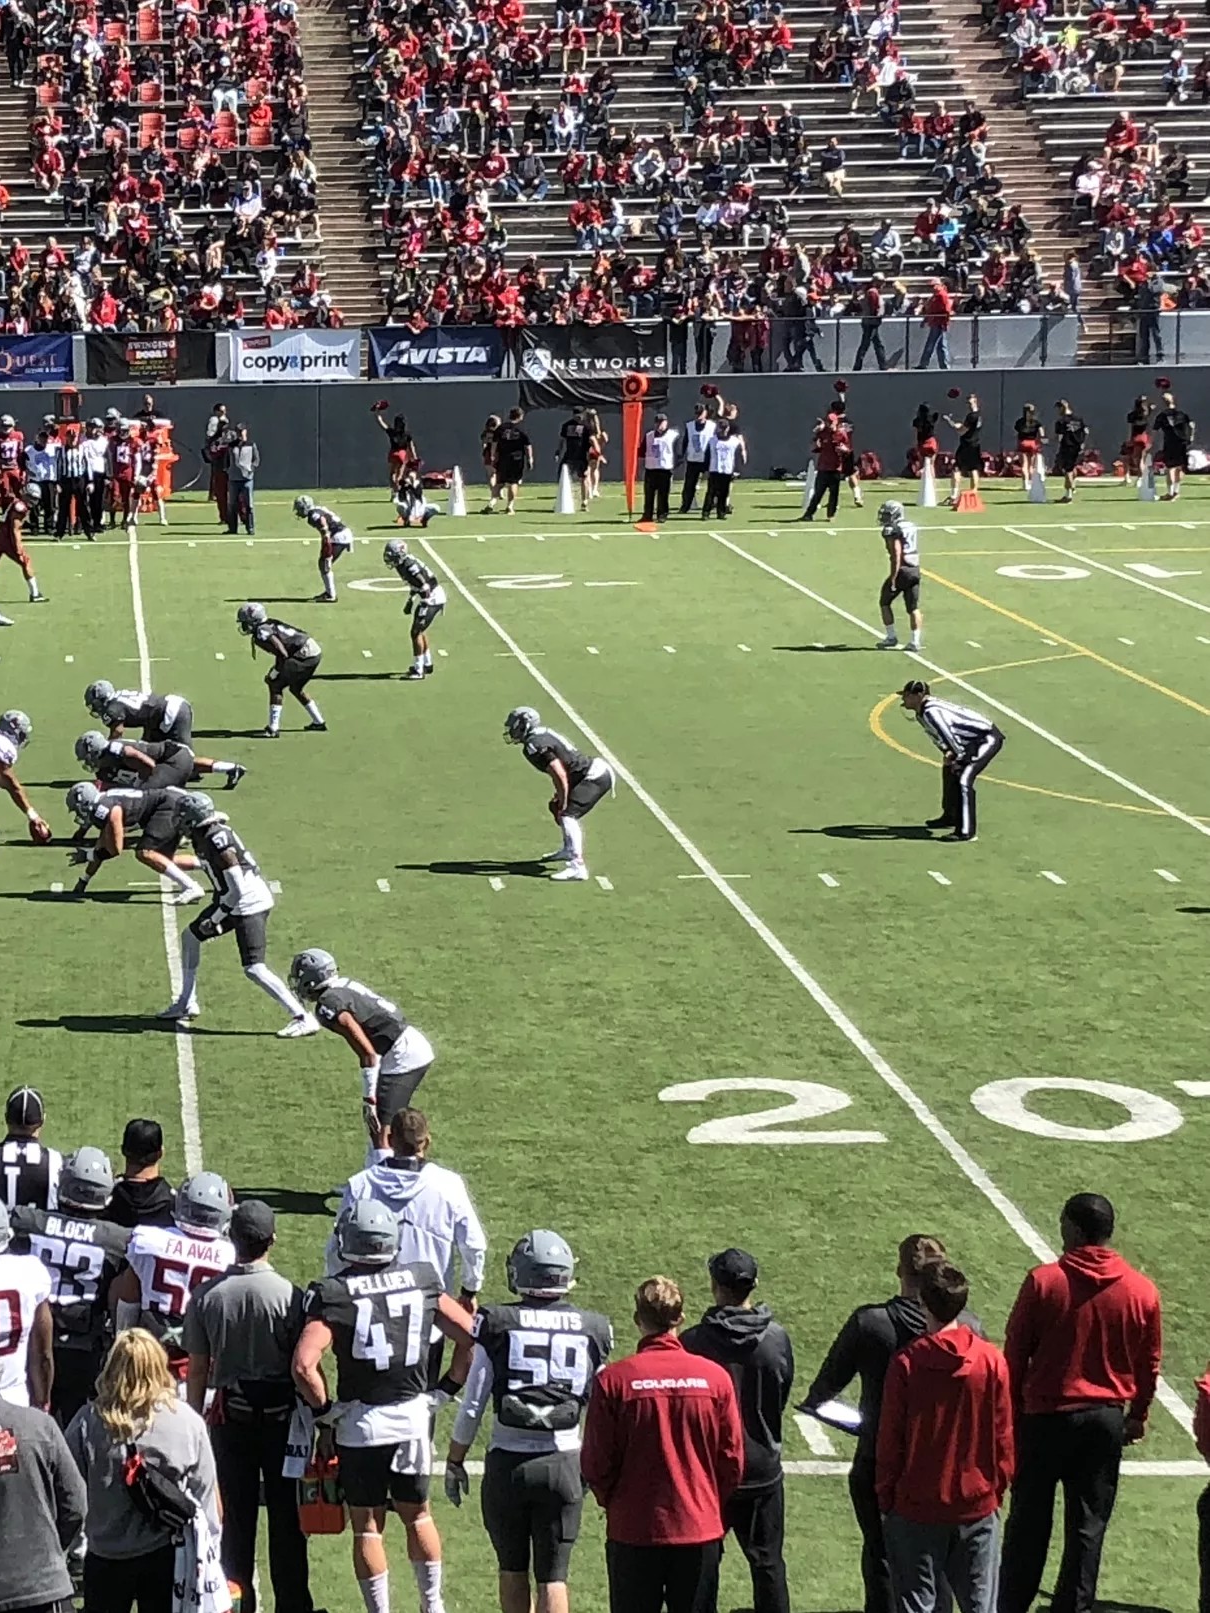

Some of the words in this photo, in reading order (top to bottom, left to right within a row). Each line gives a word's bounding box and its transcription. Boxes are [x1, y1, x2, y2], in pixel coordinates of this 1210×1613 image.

[380, 341, 488, 365] AVISTA
[553, 356, 666, 370] NETWORKS
[45, 1216, 97, 1243] BLOCK
[352, 1289, 424, 1372] 47
[507, 1329, 590, 1397] 59
[631, 1378, 710, 1391] COUGARS
